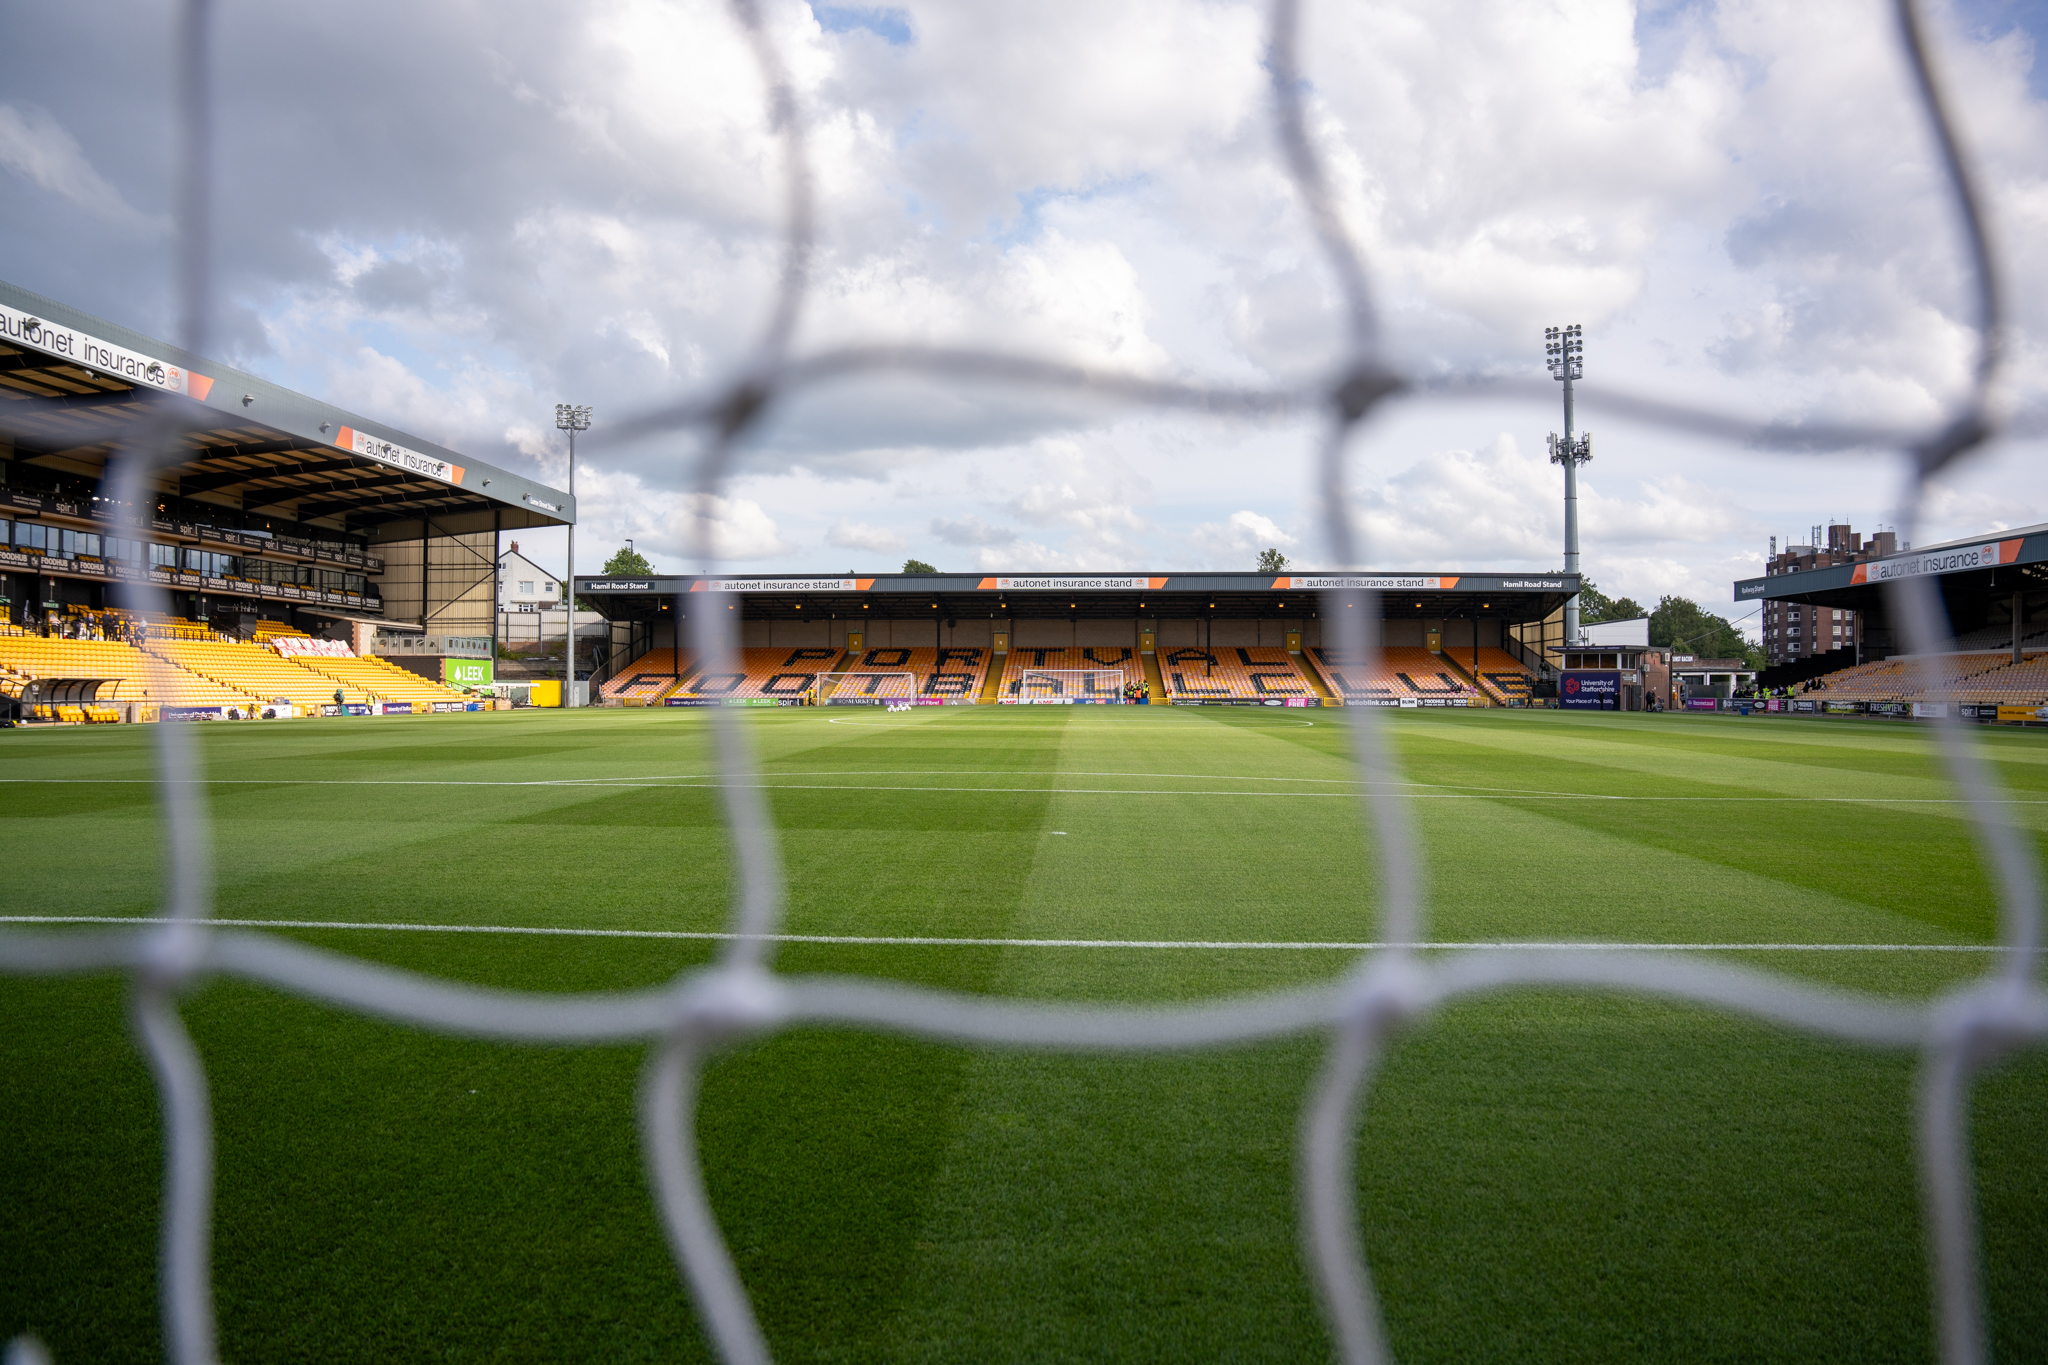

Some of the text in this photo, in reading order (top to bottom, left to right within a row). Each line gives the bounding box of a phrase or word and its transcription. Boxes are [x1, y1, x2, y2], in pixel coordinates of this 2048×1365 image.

[0, 313, 166, 386] autonet insurance
[366, 441, 443, 477] autonet insurance
[56, 502, 78, 515] spirl
[180, 524, 198, 536] spirl
[225, 531, 240, 543] spirl
[265, 539, 279, 550] spirl
[0, 552, 28, 562] FOODHUB
[41, 556, 69, 567] FOODHUB
[80, 561, 105, 572] FOODHUB
[1881, 550, 1979, 578] autonet insurance
[149, 570, 171, 580] FOODHUB
[180, 574, 200, 583] FOODHUB
[208, 577, 228, 587] FOODHUB
[235, 580, 253, 590] FOODHUB
[591, 581, 649, 590] Hamil Road Stand
[725, 580, 840, 590] autonet insurance stand
[1013, 578, 1132, 588] autonet insurance stand
[1306, 578, 1424, 587] autonet insurance stand
[462, 665, 484, 681] LEEK
[1581, 680, 1607, 689] University
[778, 698, 800, 707] spirl
[1870, 703, 1904, 712] FRESHVIEW
[1961, 707, 1978, 717] spirl
